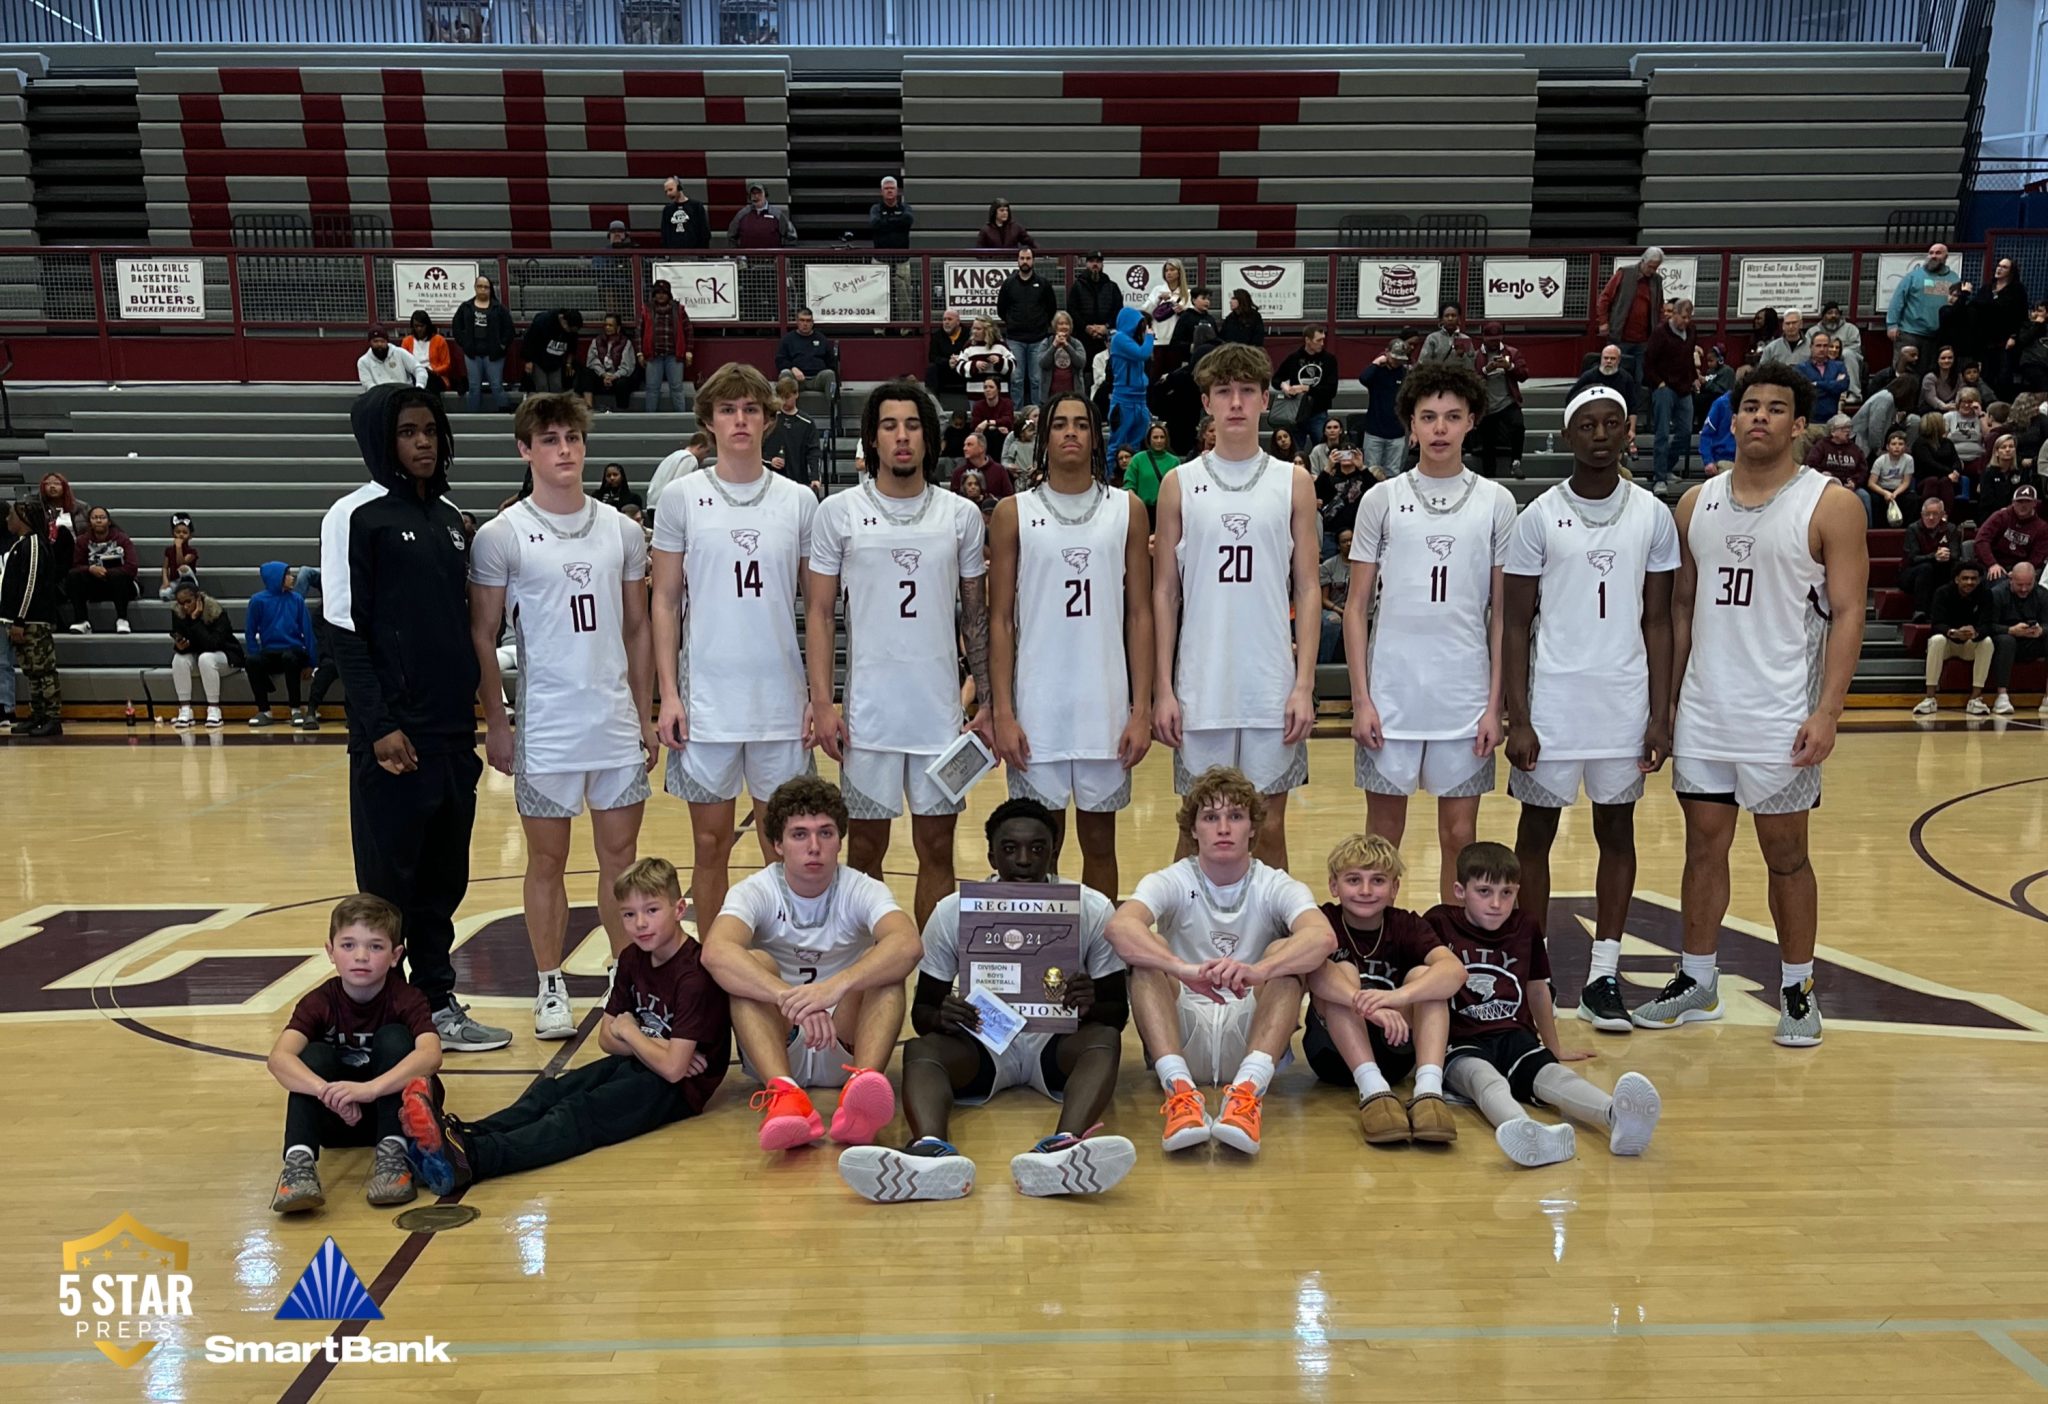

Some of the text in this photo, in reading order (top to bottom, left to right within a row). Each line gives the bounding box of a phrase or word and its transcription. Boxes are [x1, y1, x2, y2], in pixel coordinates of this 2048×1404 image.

[131, 264, 189, 272] ALCOA GIRLS
[131, 274, 190, 283] BASKETBALL
[408, 282, 466, 290] FARMERS
[130, 295, 195, 304] BUTLER'S
[684, 296, 712, 304] FAMILY
[955, 296, 998, 304] 865-414-
[821, 308, 876, 316] 865-270-3034
[1826, 453, 1855, 464] ALCOA
[1219, 545, 1252, 583] 20
[734, 560, 763, 597] 14
[1431, 565, 1447, 602] 11
[1716, 567, 1754, 606] 30
[900, 581, 917, 618] 2
[1065, 579, 1091, 617] 21
[1598, 582, 1606, 618] 1
[570, 594, 596, 632] 10
[973, 900, 1069, 913] REGIONAL
[985, 932, 1042, 945] 20 24
[630, 984, 674, 1022] ITY
[1017, 1005, 1074, 1017] PIONS
